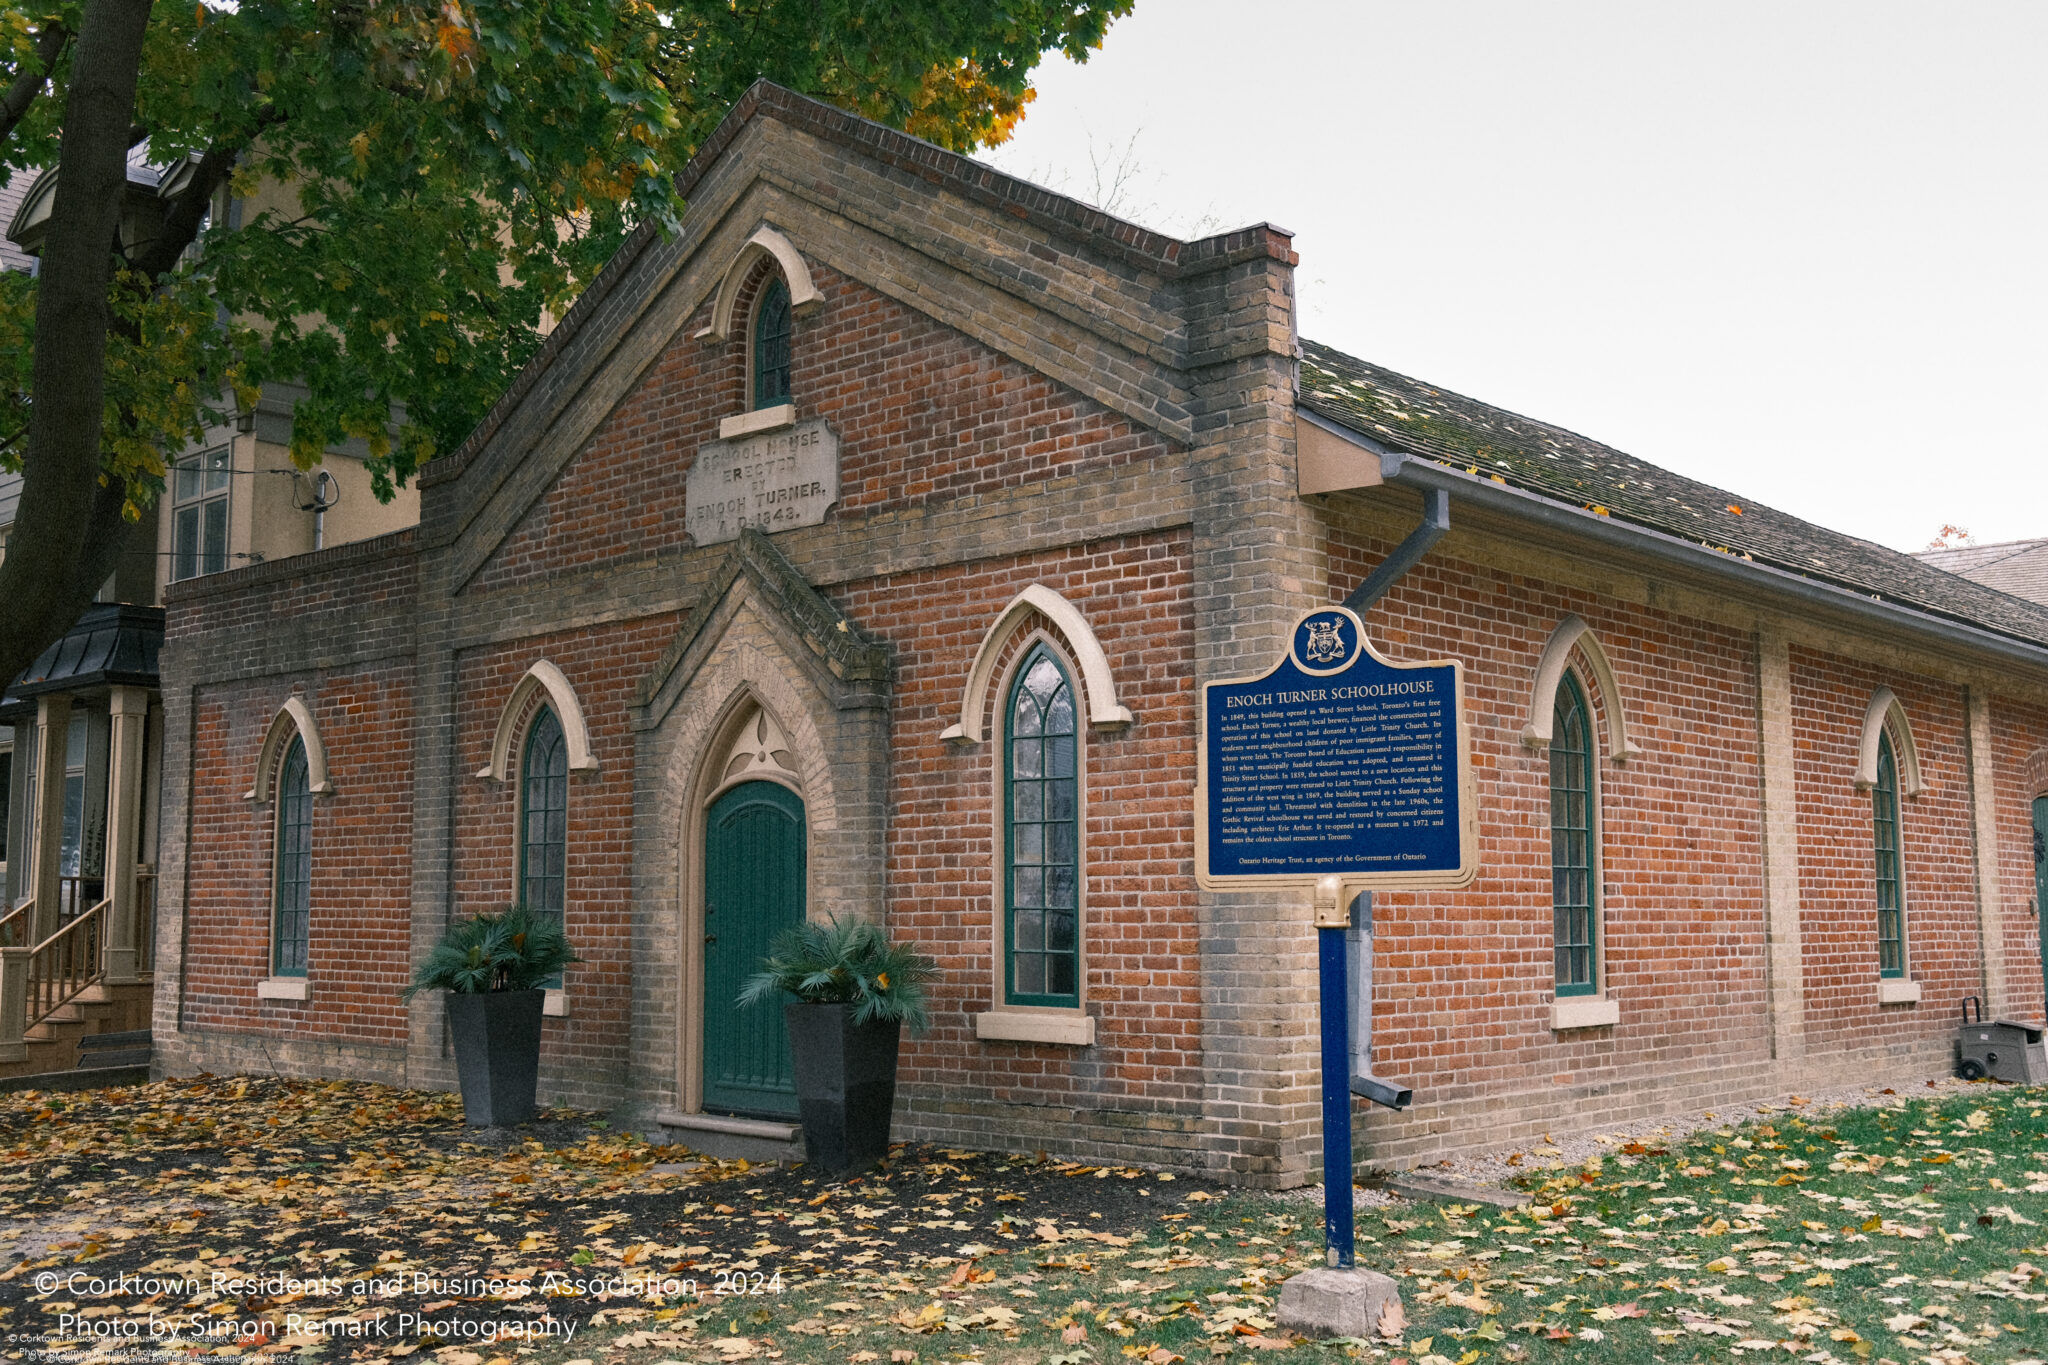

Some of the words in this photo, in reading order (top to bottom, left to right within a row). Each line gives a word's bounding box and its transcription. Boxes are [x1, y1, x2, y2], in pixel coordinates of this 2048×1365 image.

[1226, 693, 1272, 708] ENOCH
[1276, 689, 1327, 704] TURNER
[1331, 680, 1434, 700] SCHOOLHOUSE
[1286, 708, 1307, 717] opened
[1381, 701, 1410, 710] Toronto's
[1242, 722, 1260, 730] Enoch
[1351, 713, 1376, 722] financed
[1429, 709, 1441, 717] and
[1274, 730, 1292, 738] school
[1361, 724, 1377, 732] Little
[1308, 749, 1326, 757] Board
[1366, 745, 1391, 753] assumed
[1392, 743, 1433, 753] responsibility
[1257, 761, 1289, 770] municipally
[1406, 753, 1433, 762] renamed
[1259, 784, 1283, 792] property
[1300, 780, 1325, 789] returned
[1400, 776, 1431, 784] Following
[1335, 790, 1360, 798] building
[1398, 787, 1420, 795] Sunday
[1422, 785, 1443, 794] school
[1284, 802, 1317, 810] Threatened
[1266, 814, 1300, 822] schoolhouse
[1386, 808, 1418, 817] concerned
[1222, 826, 1248, 834] including
[1324, 822, 1354, 831] re-opened
